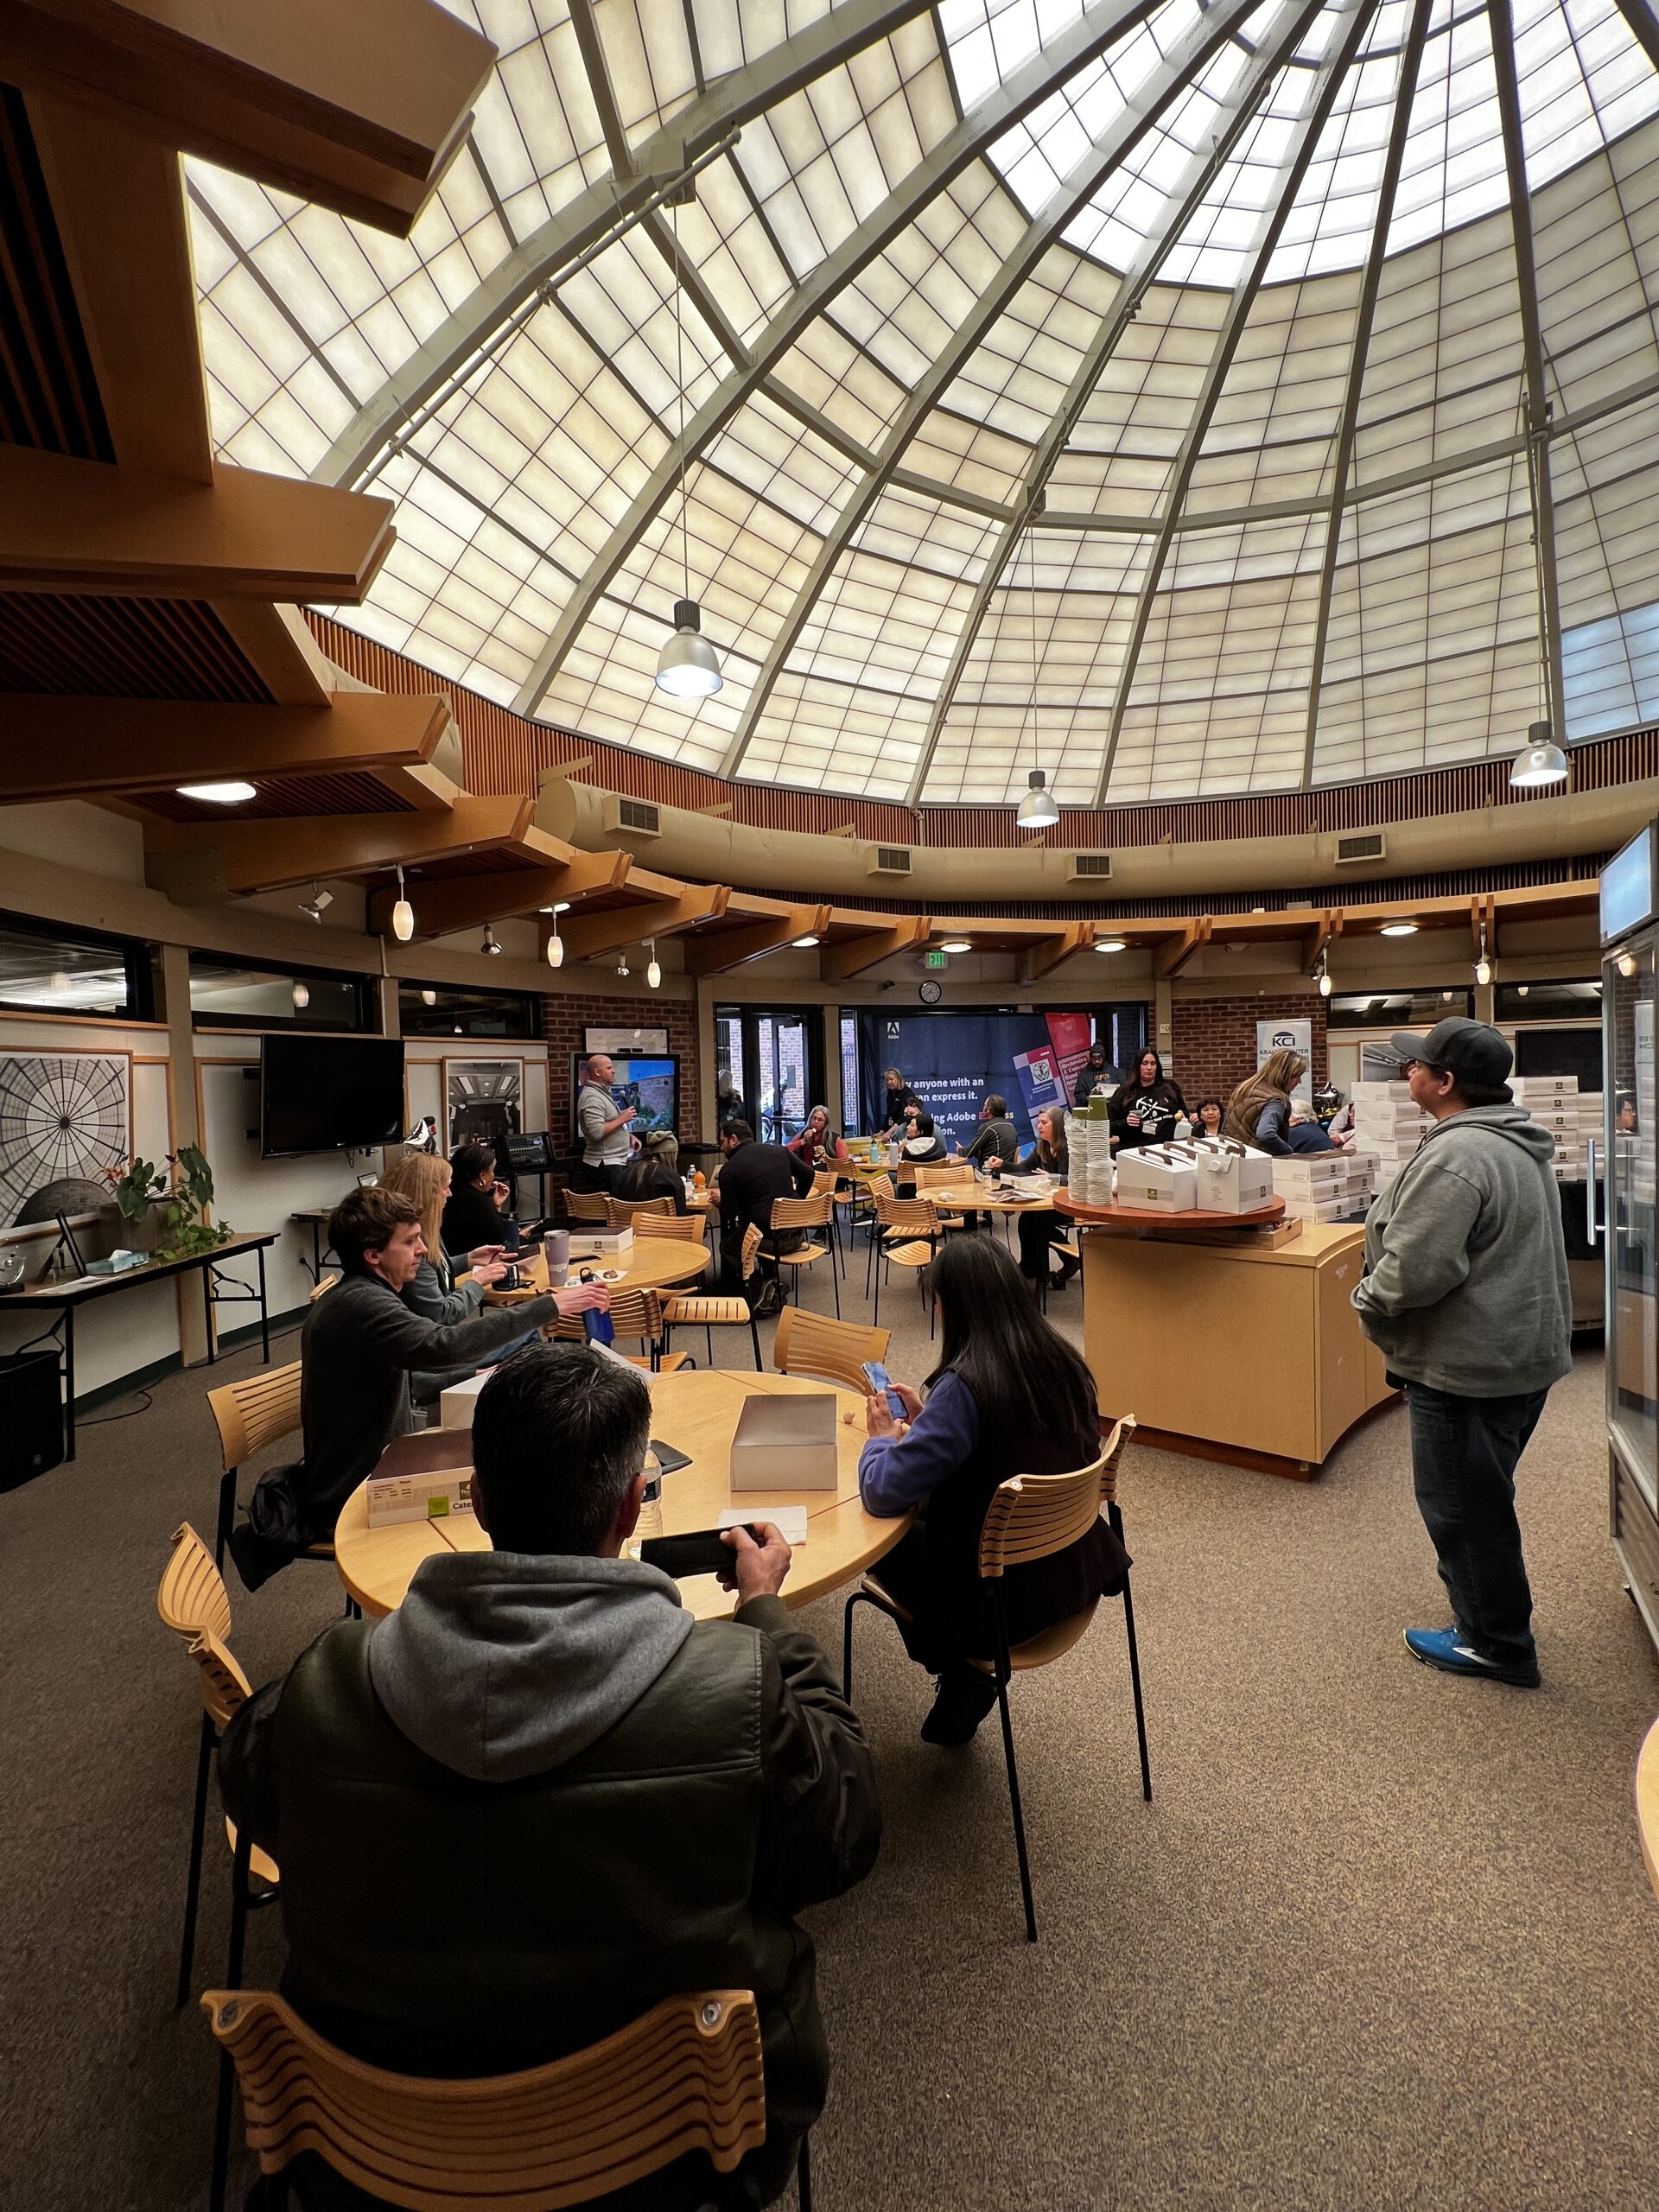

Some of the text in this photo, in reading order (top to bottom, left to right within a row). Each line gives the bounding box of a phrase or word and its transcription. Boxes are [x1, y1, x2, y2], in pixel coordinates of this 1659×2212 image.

[928, 953, 944, 967] EXIT
[1272, 1037, 1296, 1046] KCI
[1061, 1057, 1087, 1069] Orchestra
[913, 1080, 948, 1090] anyone
[950, 1077, 970, 1087] with
[931, 1092, 966, 1103] express
[968, 1090, 978, 1100] it.
[946, 1112, 976, 1122] Adobe
